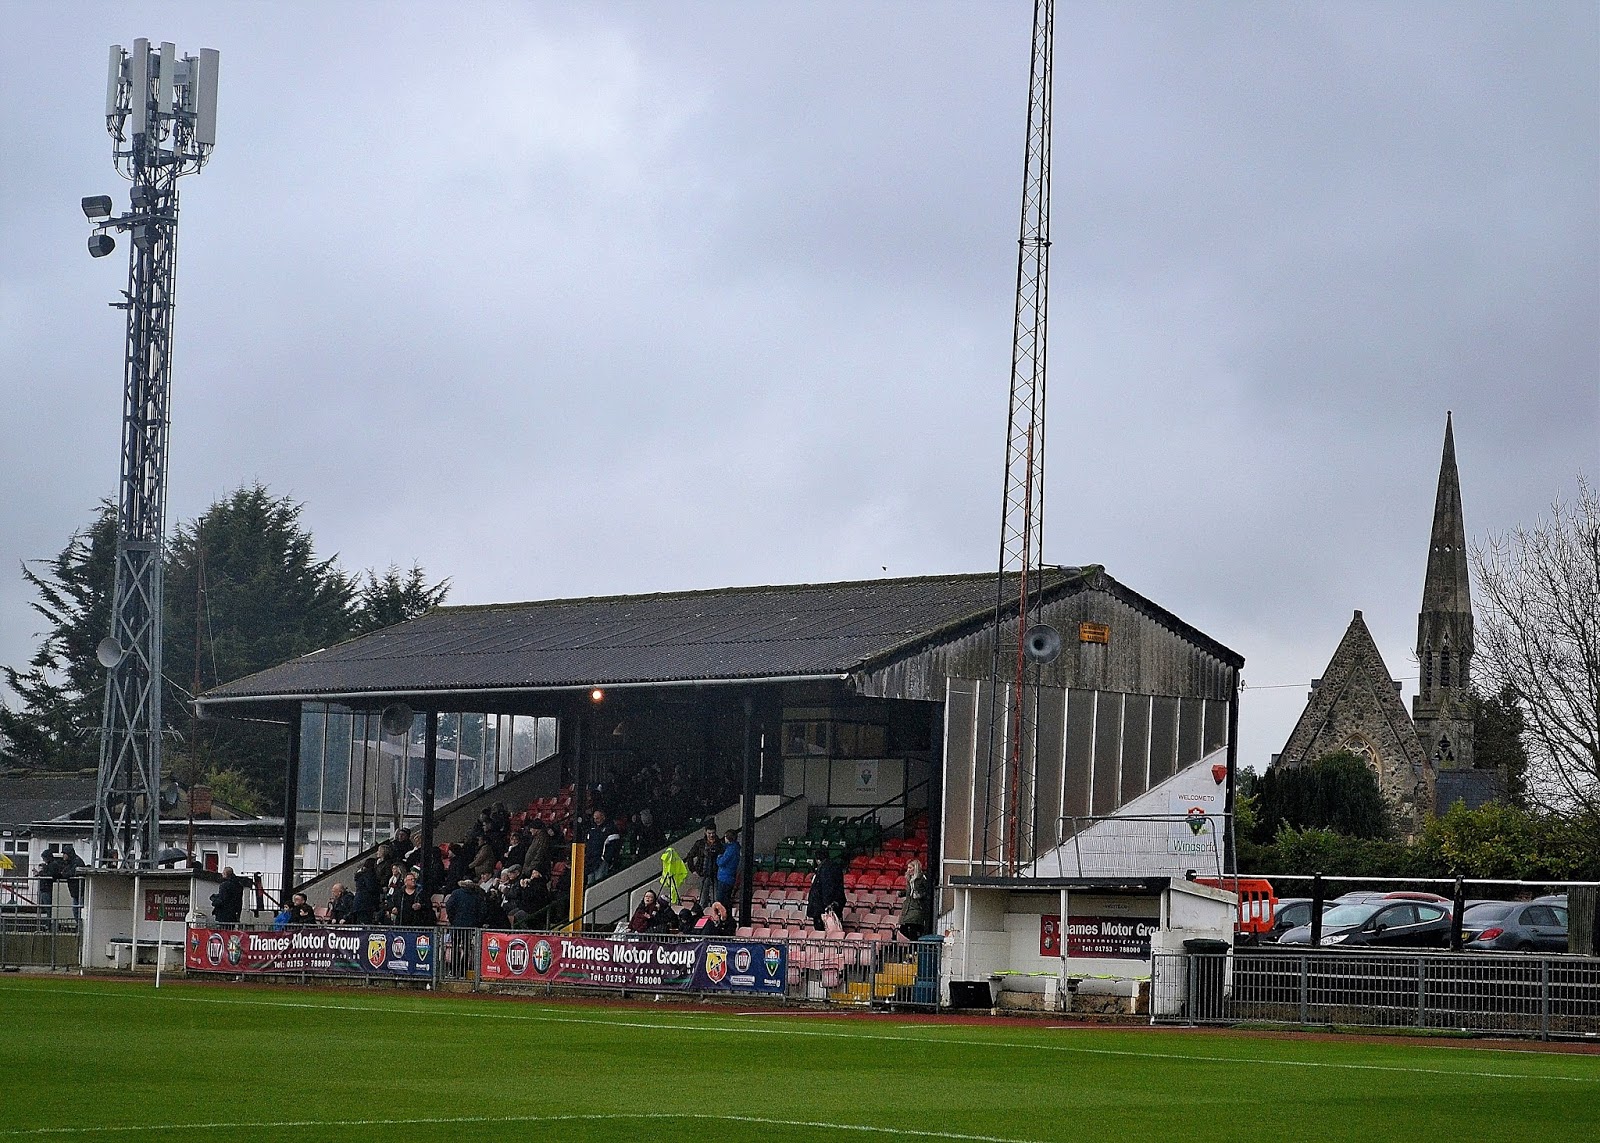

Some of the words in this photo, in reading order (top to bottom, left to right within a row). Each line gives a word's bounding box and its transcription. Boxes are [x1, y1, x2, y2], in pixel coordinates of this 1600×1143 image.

[1101, 922, 1134, 936] Motor
[1136, 923, 1161, 937] Gro
[249, 935, 290, 951] Thames
[292, 932, 325, 949] Motor
[328, 932, 360, 954] Group
[1094, 945, 1113, 953] 01753
[511, 949, 525, 966] FIAT
[560, 940, 610, 961] Thames
[612, 944, 653, 964] Motor
[656, 945, 696, 968] Group
[273, 961, 285, 969] Tel:
[286, 960, 304, 968] 01753
[590, 972, 604, 981] Tel:
[605, 973, 627, 983] 01753
[635, 975, 662, 985] 788000
